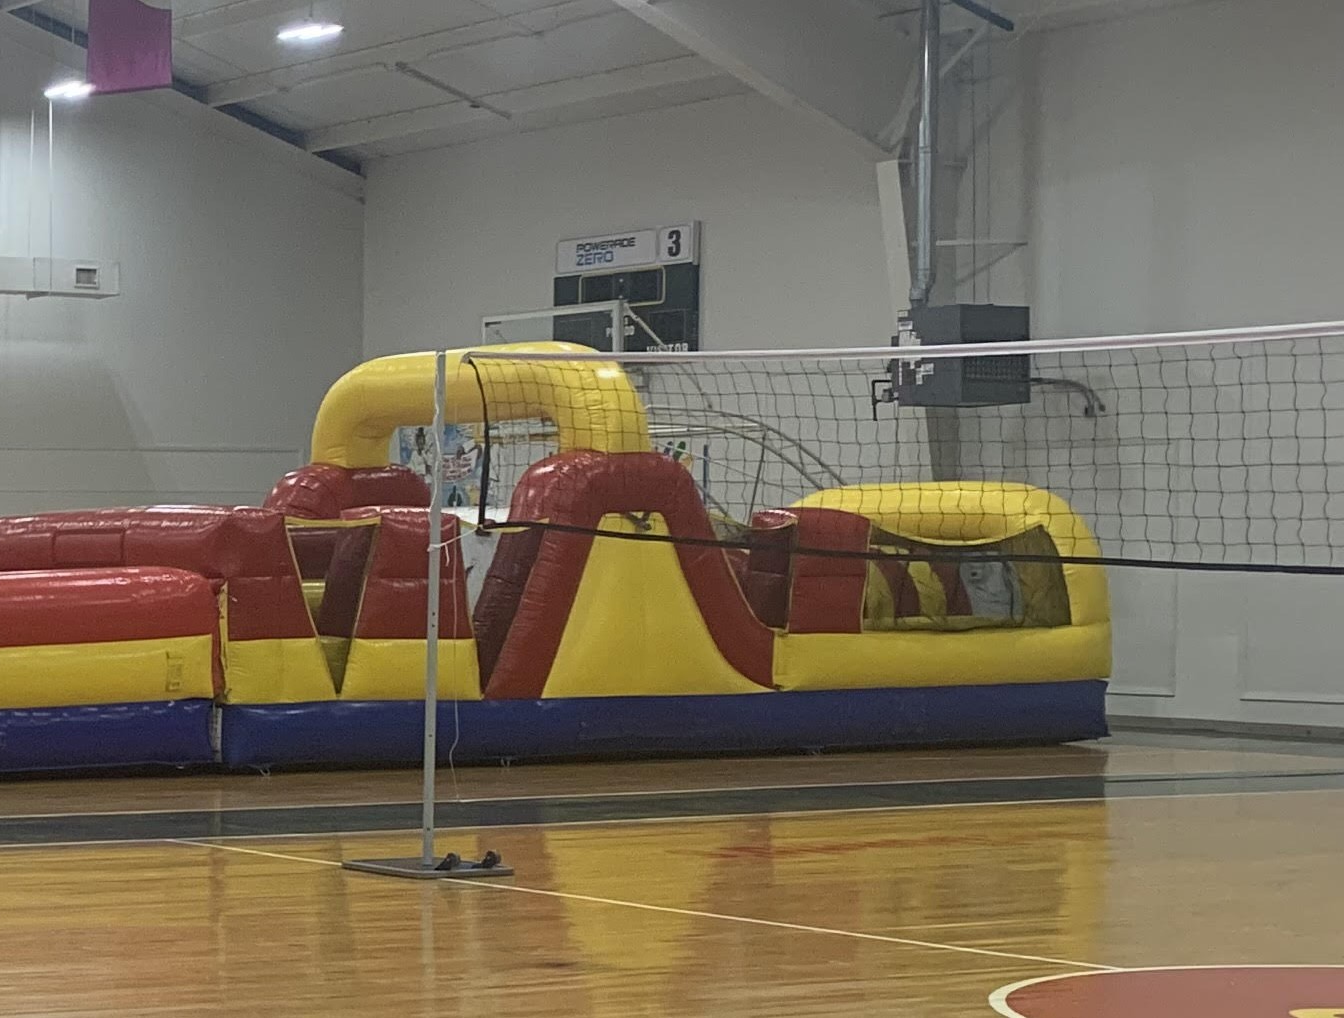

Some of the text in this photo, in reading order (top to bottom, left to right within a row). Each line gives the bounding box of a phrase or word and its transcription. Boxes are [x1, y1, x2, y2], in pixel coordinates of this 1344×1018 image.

[575, 236, 637, 254] POWERADE
[668, 229, 681, 257] 3
[575, 251, 614, 266] ZERO
